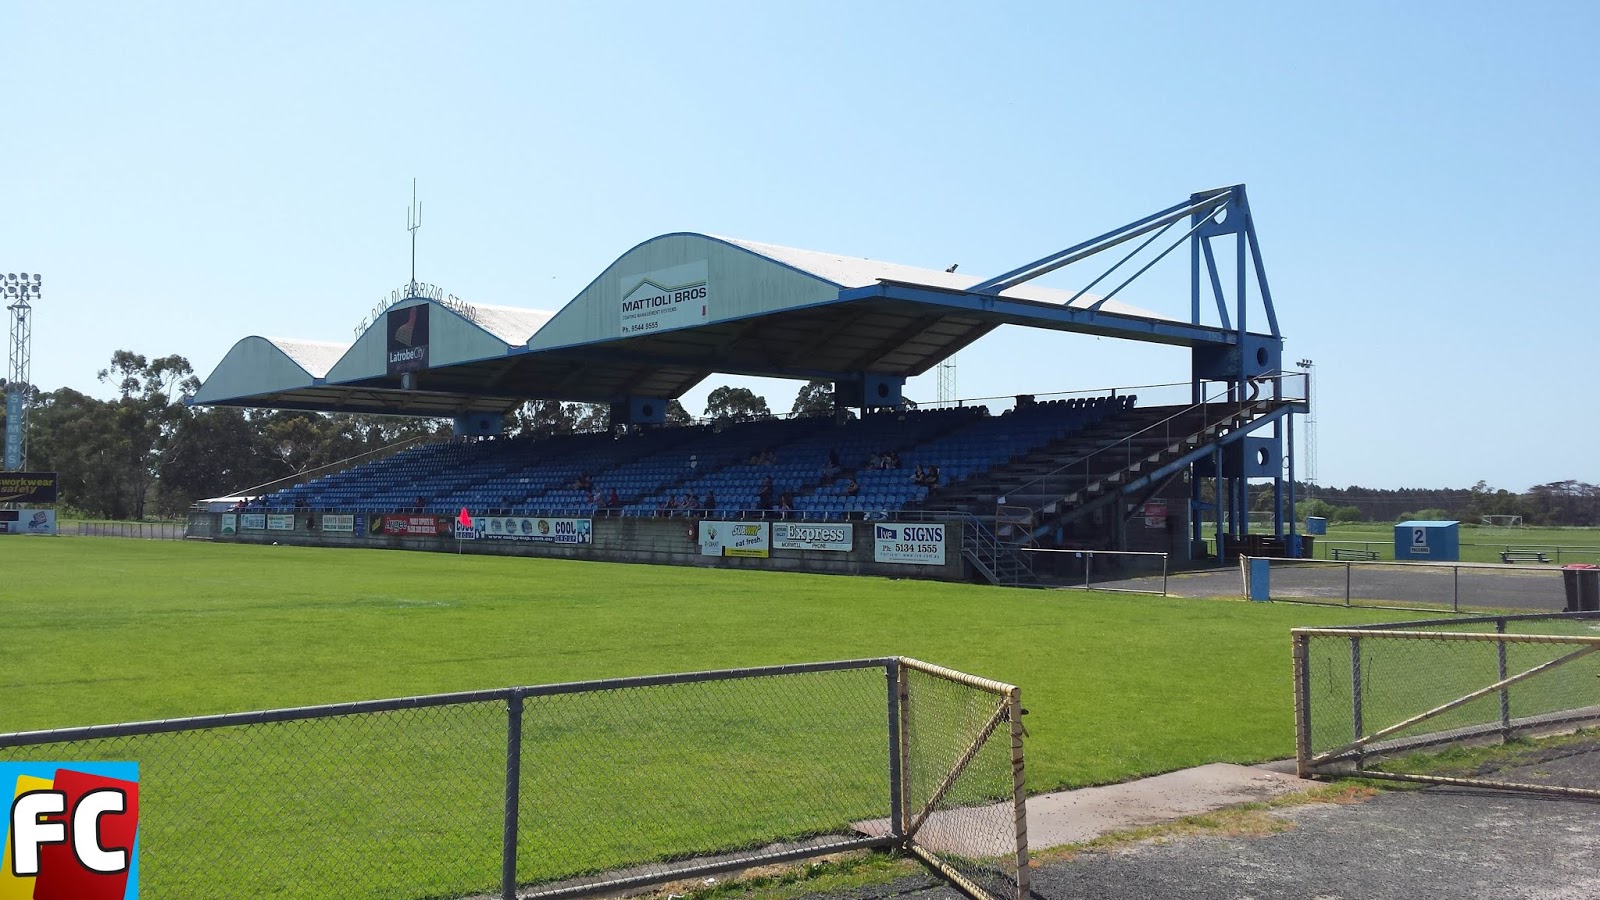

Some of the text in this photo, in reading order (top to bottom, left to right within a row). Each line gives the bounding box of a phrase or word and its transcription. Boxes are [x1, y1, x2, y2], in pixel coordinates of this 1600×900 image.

[622, 287, 706, 312] MATTIOLI BROS
[354, 317, 367, 339] THE
[371, 297, 389, 320] DON
[403, 282, 443, 304] FABRIZIO
[448, 293, 478, 320] STAND
[637, 309, 660, 318] MANAGEMENT
[7, 394, 19, 464] SIEMENS
[0, 477, 54, 486] workwear
[1, 485, 37, 494] safety
[555, 521, 576, 534] COOL
[732, 524, 762, 536] SUBWAY
[787, 524, 845, 543] Express
[735, 536, 763, 547] eat fresh.
[903, 528, 942, 542] SIGNS
[1414, 529, 1424, 543] 2
[895, 543, 914, 552] 5134
[917, 544, 938, 553] 1555
